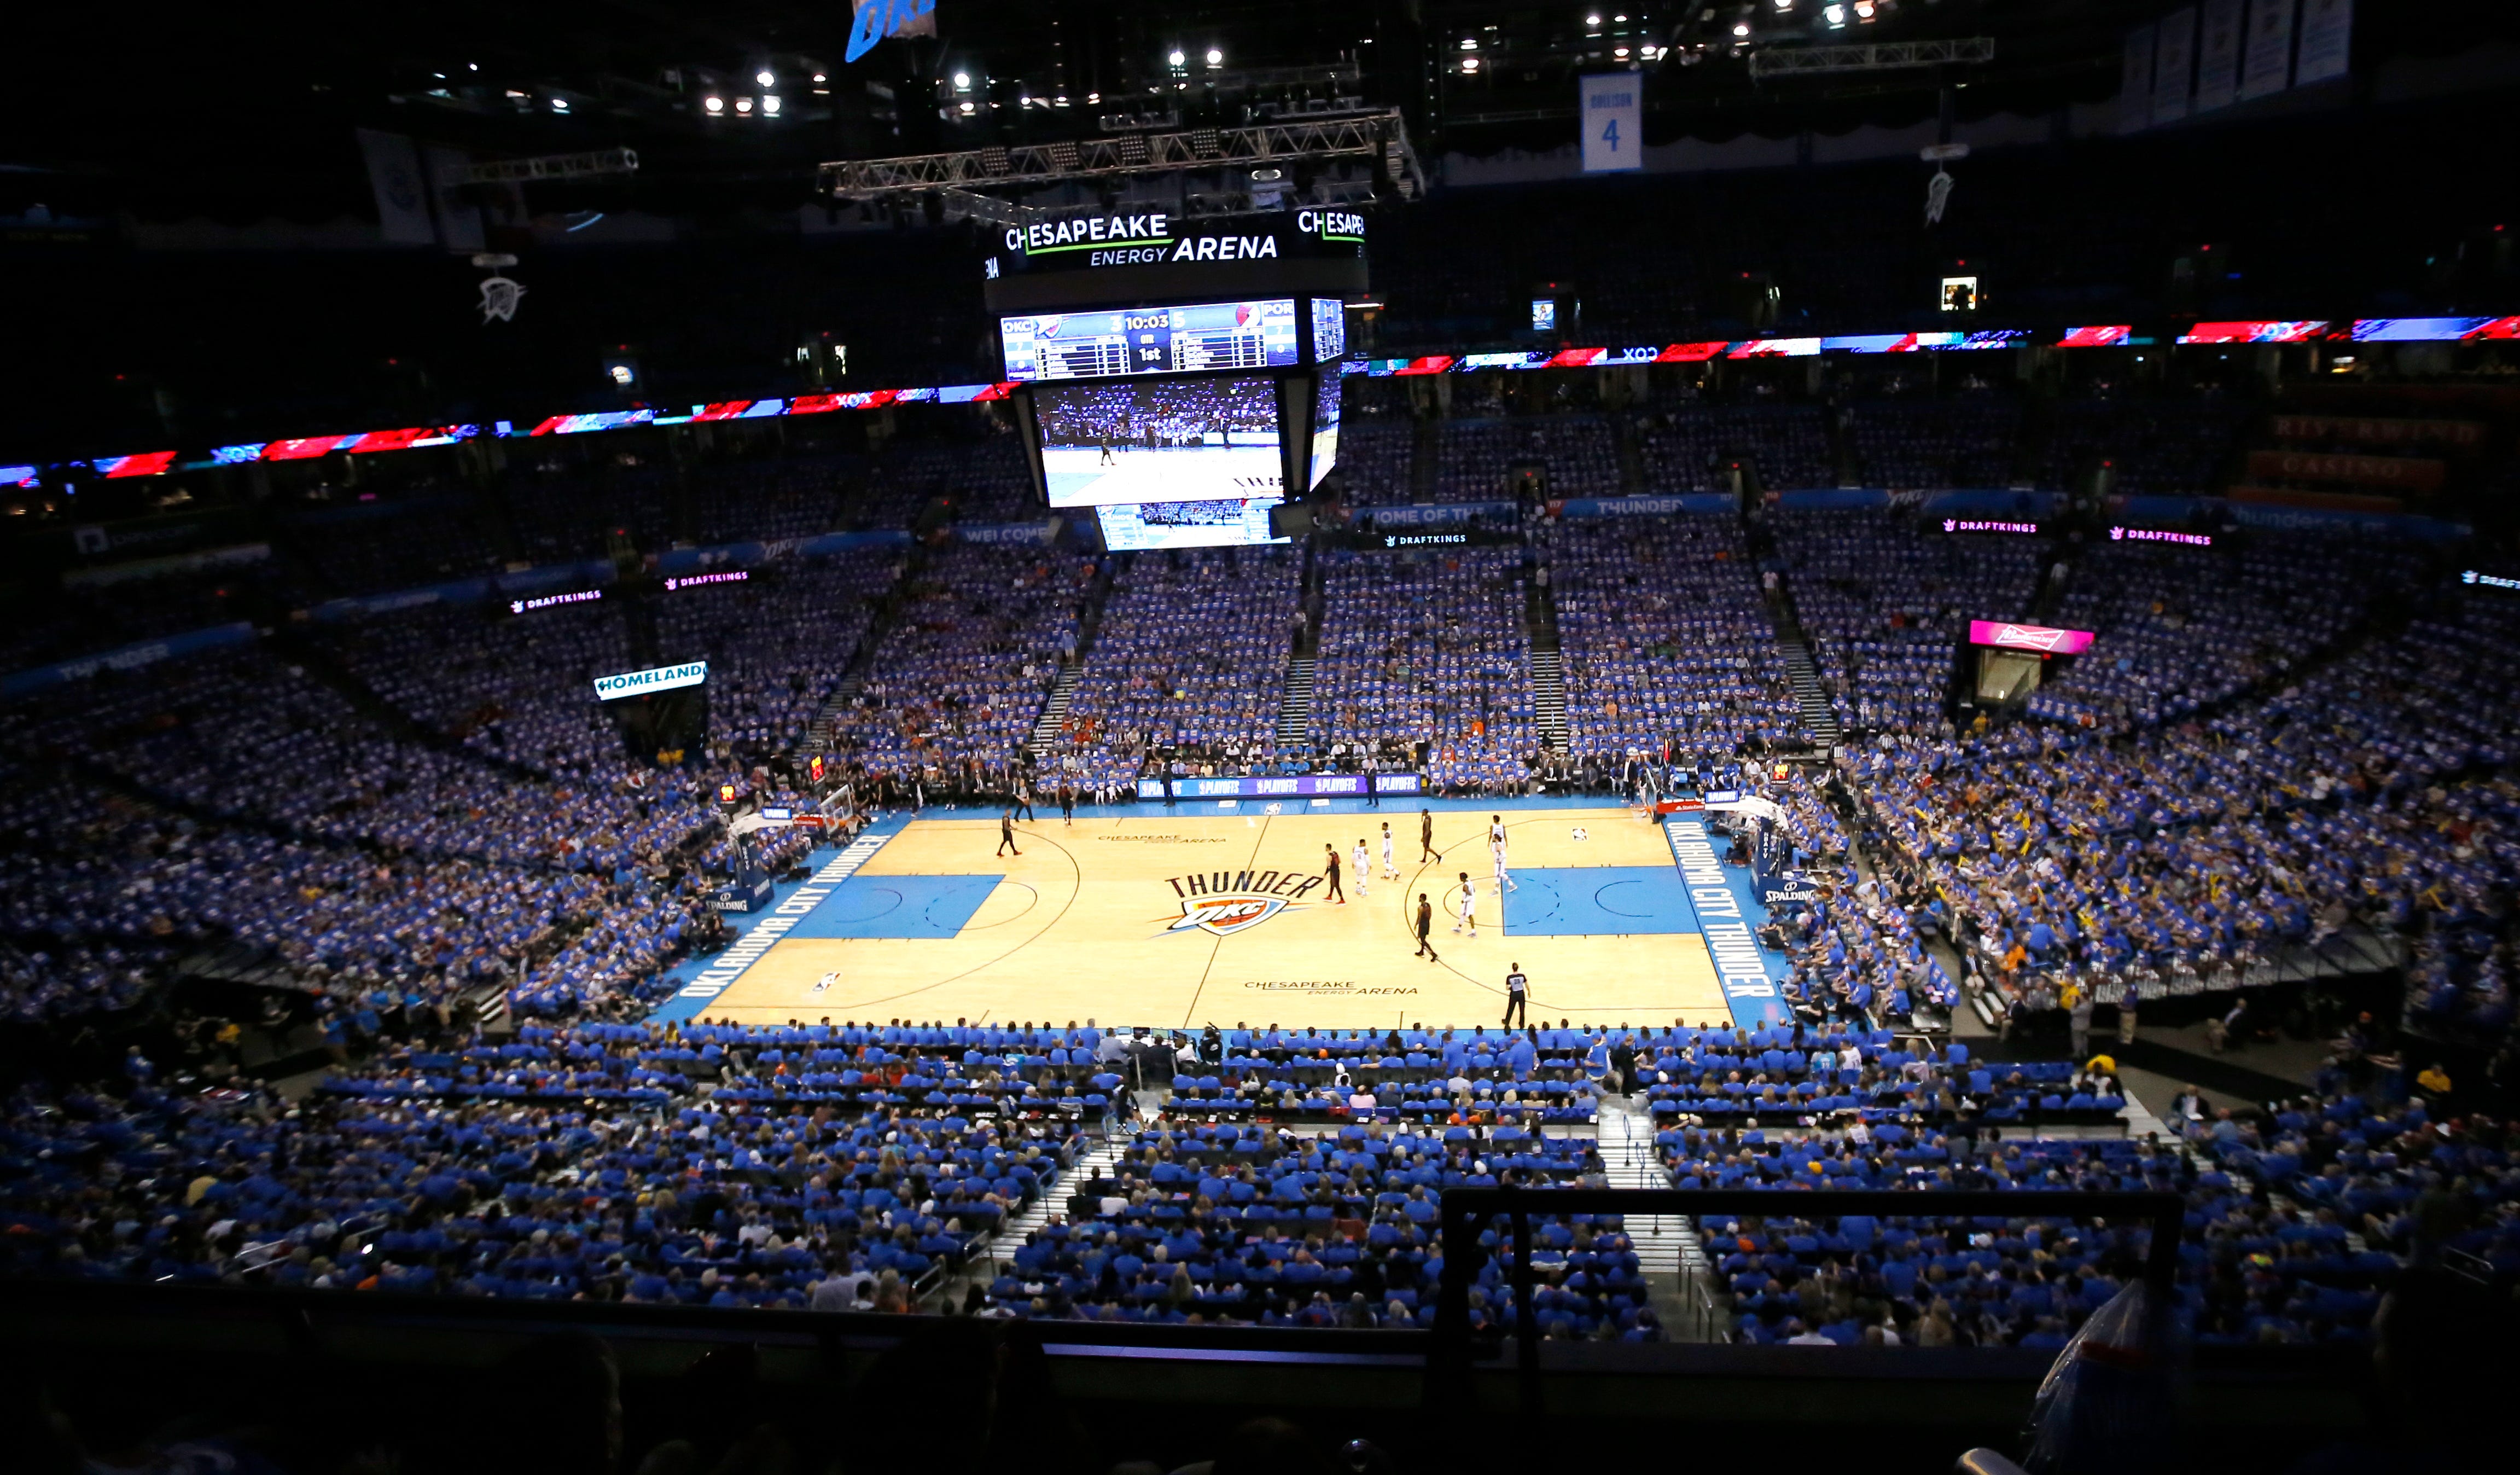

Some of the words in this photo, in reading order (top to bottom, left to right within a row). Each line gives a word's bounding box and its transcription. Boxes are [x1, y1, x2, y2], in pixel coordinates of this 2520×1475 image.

[1602, 119, 1620, 152] 4
[1006, 214, 1168, 252] CHESAPEAKE
[1090, 248, 1168, 266] ENERGY
[1172, 235, 1277, 262] ARENA
[1003, 321, 1031, 333] OKC
[1109, 316, 1122, 332] 3
[1125, 315, 1169, 330] 10:03
[1173, 311, 1185, 328] 5
[1264, 303, 1293, 316] POR
[1139, 347, 1161, 361] 1st
[1423, 510, 1447, 522] OF
[1959, 521, 2036, 533] DRAFTKINGS
[2126, 529, 2211, 546] DRAFTKINGS
[1400, 535, 1466, 545] DRAFTKINGS
[680, 571, 748, 586] DRAFTKINGS
[527, 590, 602, 608] DRAFTKINGS
[601, 665, 701, 690] HOMELAND
[1205, 780, 1239, 794] PLAYOFFS
[1264, 779, 1298, 793] PLAYOFFS
[1322, 777, 1357, 792] PLAYOFFS
[1382, 776, 1416, 791] PLAYOFFS
[1667, 821, 1726, 885] OKLAHOMA
[1165, 870, 1324, 898] THUNDER
[1692, 887, 1742, 918] CITY
[679, 917, 799, 997] OKLAHOMA
[775, 886, 831, 914] CITY
[807, 834, 892, 885] THUNDER
[1166, 900, 1266, 930] OKC
[1704, 921, 1776, 997] THUNDER
